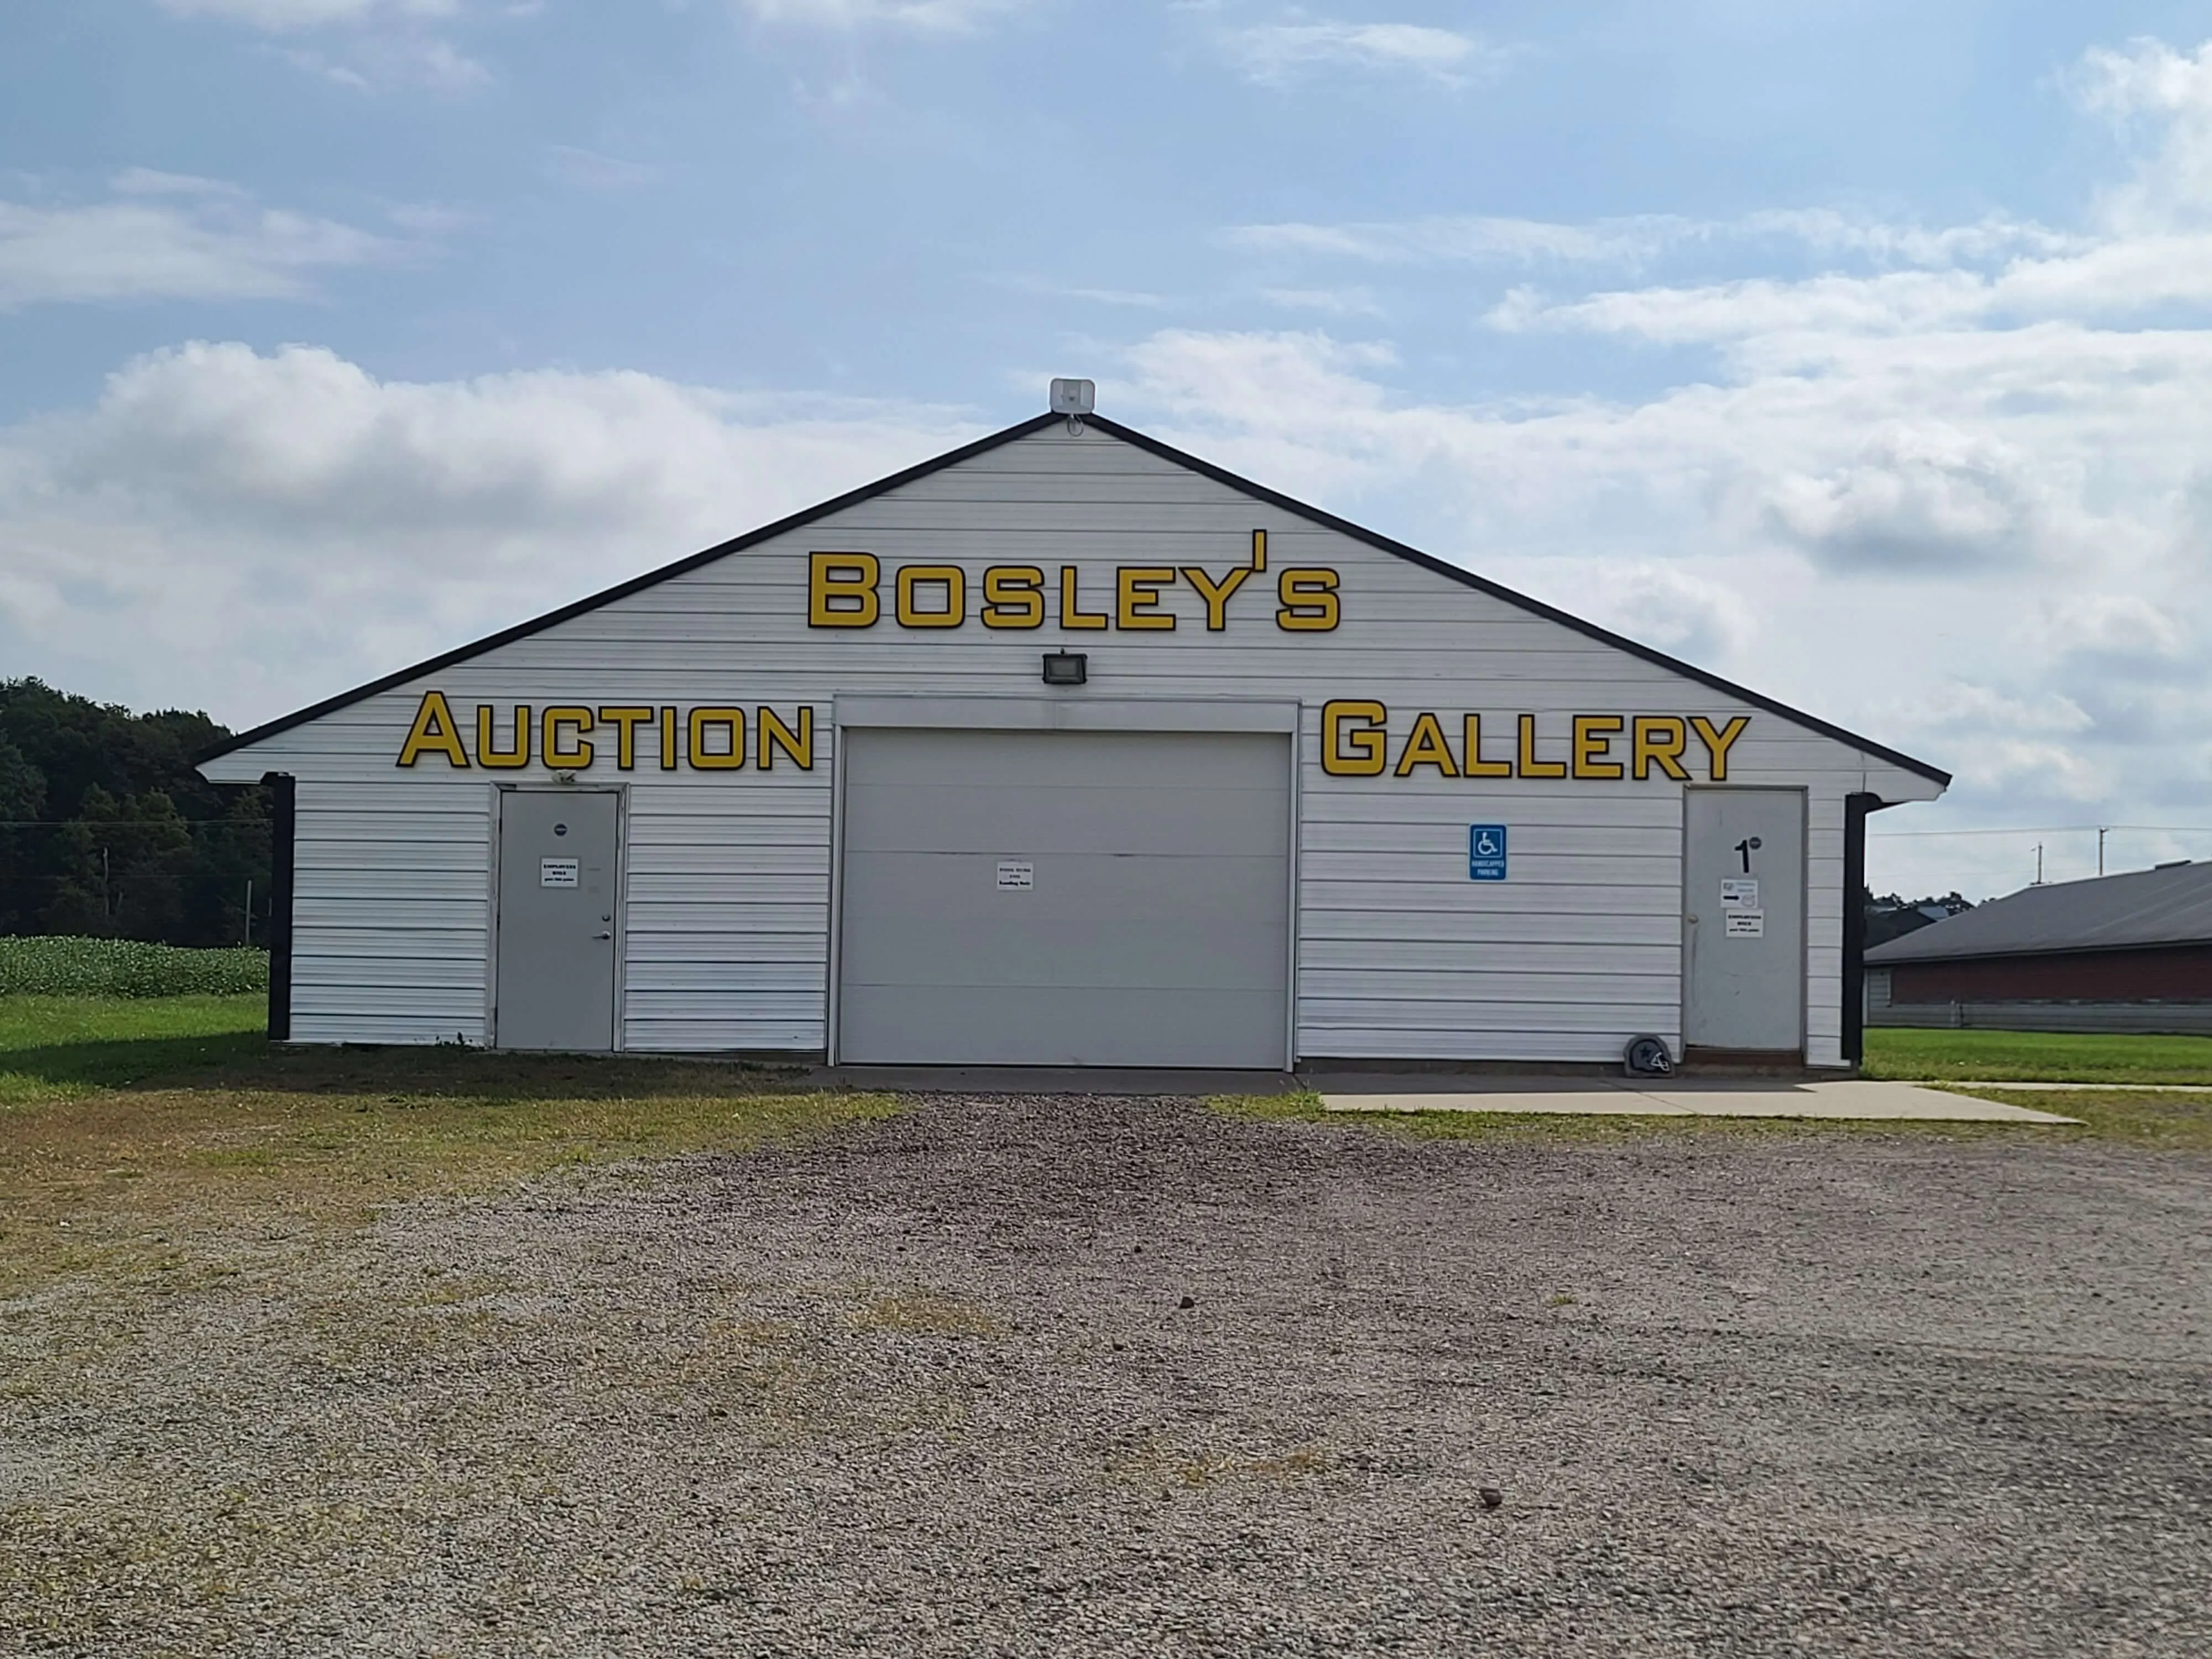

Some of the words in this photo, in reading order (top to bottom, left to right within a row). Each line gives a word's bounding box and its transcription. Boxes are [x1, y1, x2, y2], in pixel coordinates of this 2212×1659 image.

[808, 529, 1340, 632] BOSLEY'S
[395, 690, 813, 771] AUCTION
[1321, 699, 1752, 780] GALLERY
[1734, 839, 1749, 873] 1
